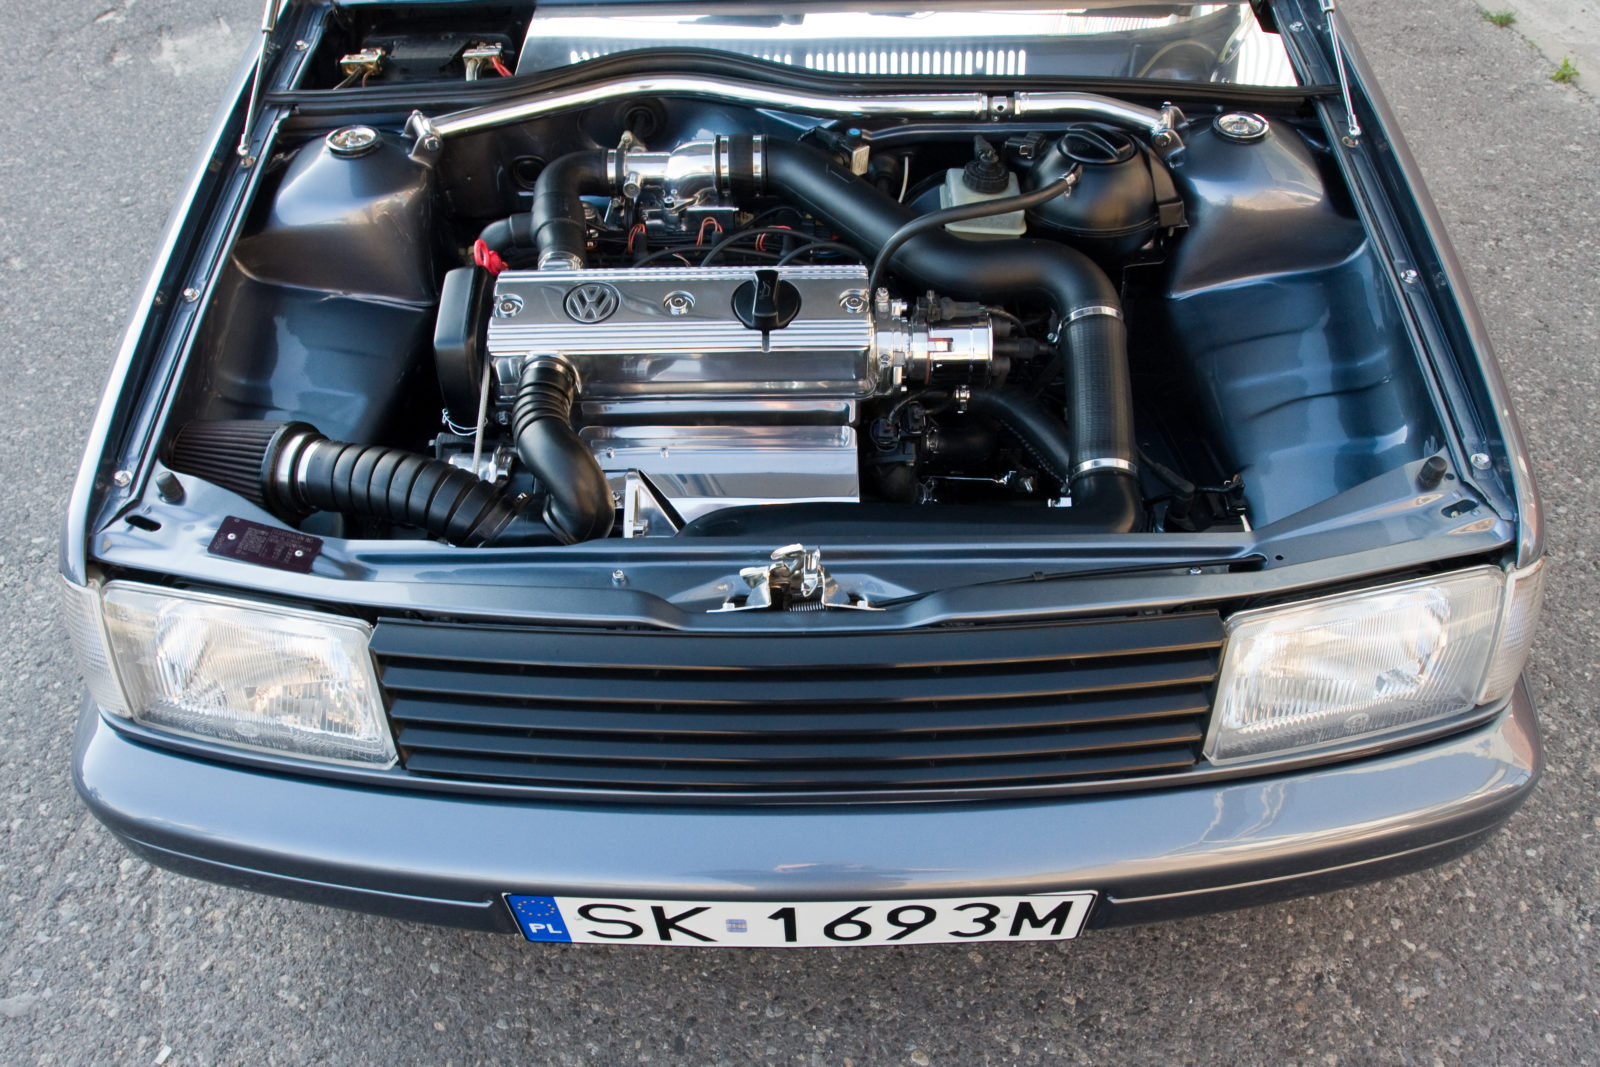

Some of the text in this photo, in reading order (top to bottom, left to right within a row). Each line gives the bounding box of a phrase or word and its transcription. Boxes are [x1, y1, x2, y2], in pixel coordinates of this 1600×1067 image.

[565, 284, 618, 323] VW
[528, 922, 562, 934] PL
[577, 901, 1074, 942] SK 1693M
